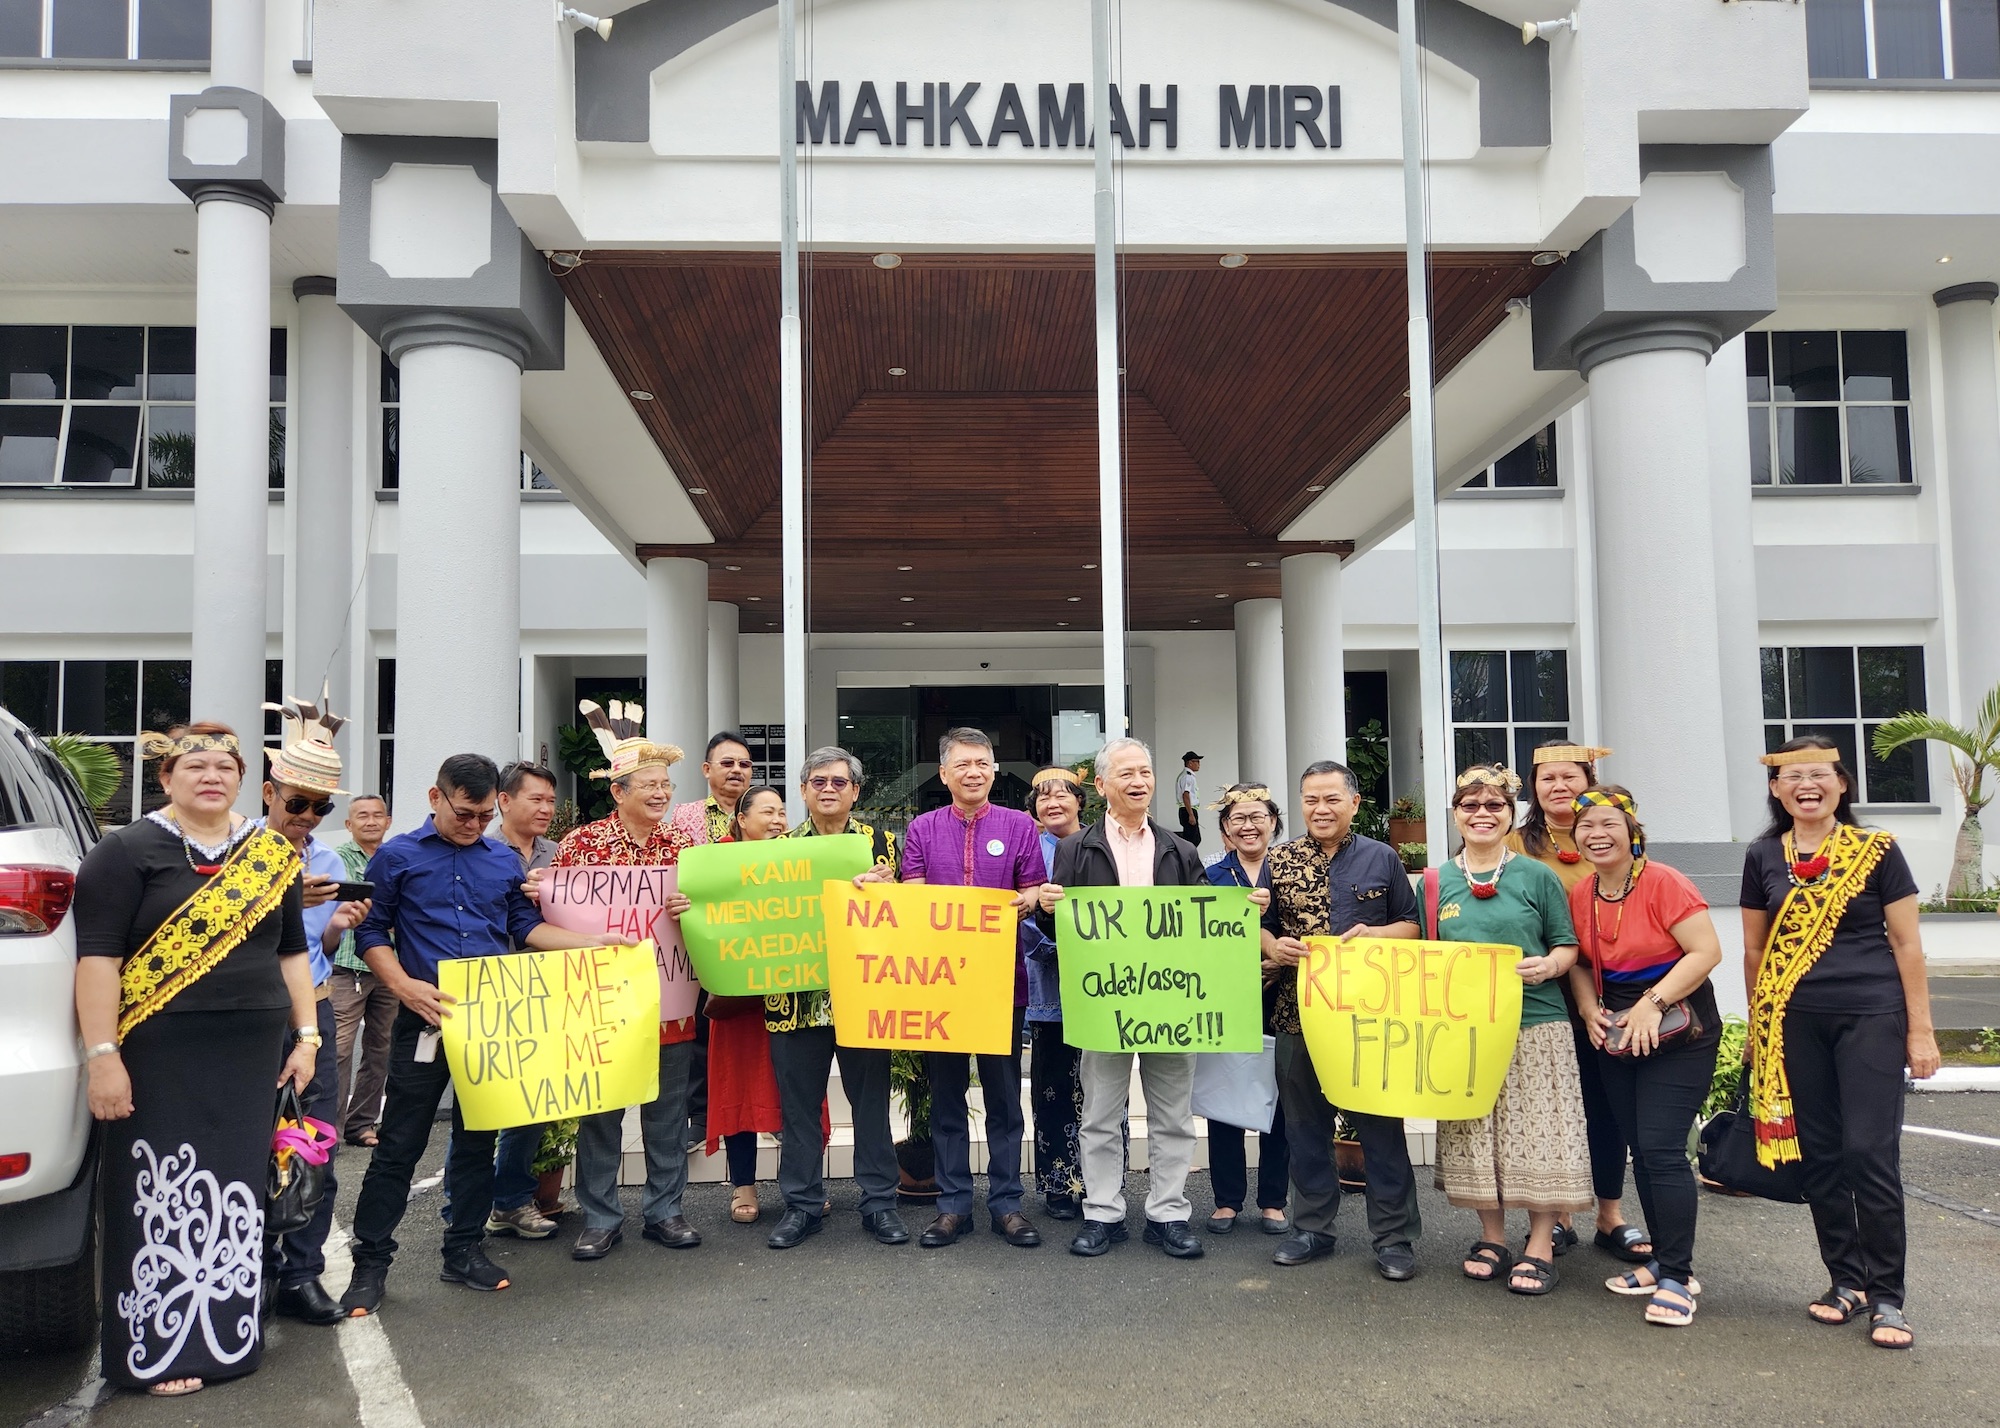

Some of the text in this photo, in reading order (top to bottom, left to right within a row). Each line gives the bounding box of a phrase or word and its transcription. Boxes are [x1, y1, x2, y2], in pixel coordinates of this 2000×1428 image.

[796, 80, 1342, 148] MAHKAMAH MIRI
[551, 869, 668, 906] HORMAT
[740, 858, 812, 886] KAMI
[606, 907, 664, 946] HAK
[706, 894, 824, 925] MENGUT
[846, 899, 1001, 933] NA ULE
[1072, 898, 1127, 940] UK
[747, 961, 824, 990] LICIK
[856, 954, 966, 985] TANA'
[1304, 941, 1515, 1023] RESPECT
[457, 994, 551, 1041] TUKIT
[868, 1010, 950, 1040] MEK
[465, 1039, 538, 1086] URIP
[1352, 1014, 1476, 1097] FPIC!
[520, 1071, 602, 1119] VAM!
